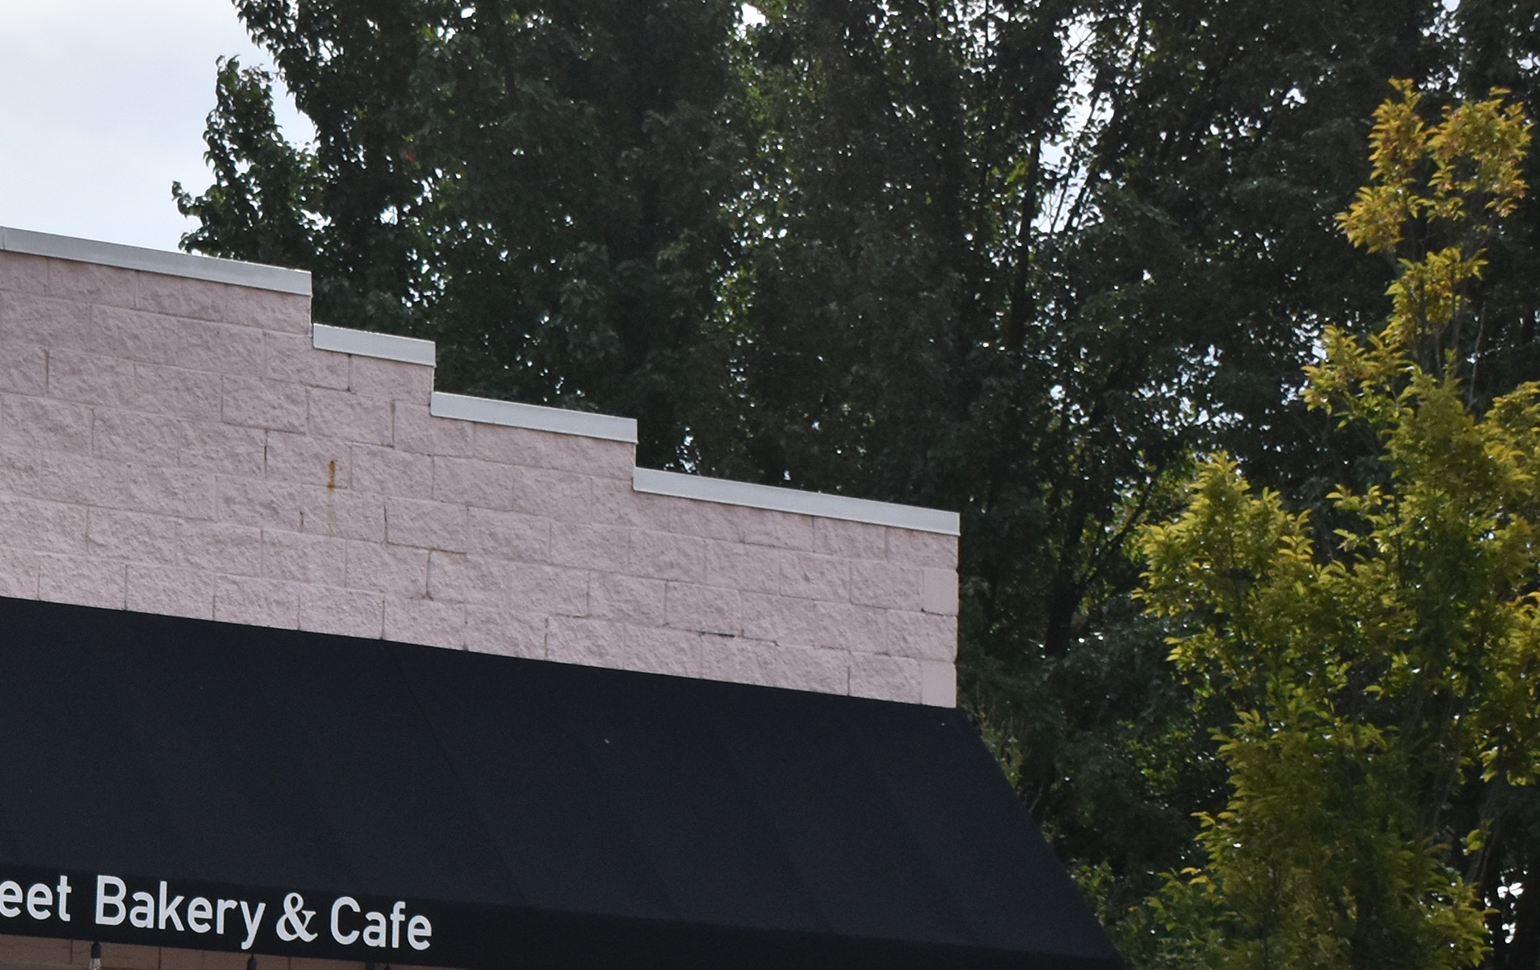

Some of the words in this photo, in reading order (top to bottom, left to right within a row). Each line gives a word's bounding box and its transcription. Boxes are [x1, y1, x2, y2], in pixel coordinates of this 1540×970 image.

[94, 875, 267, 950] Bakery
[275, 893, 319, 943] &
[330, 895, 433, 952] Cafe
